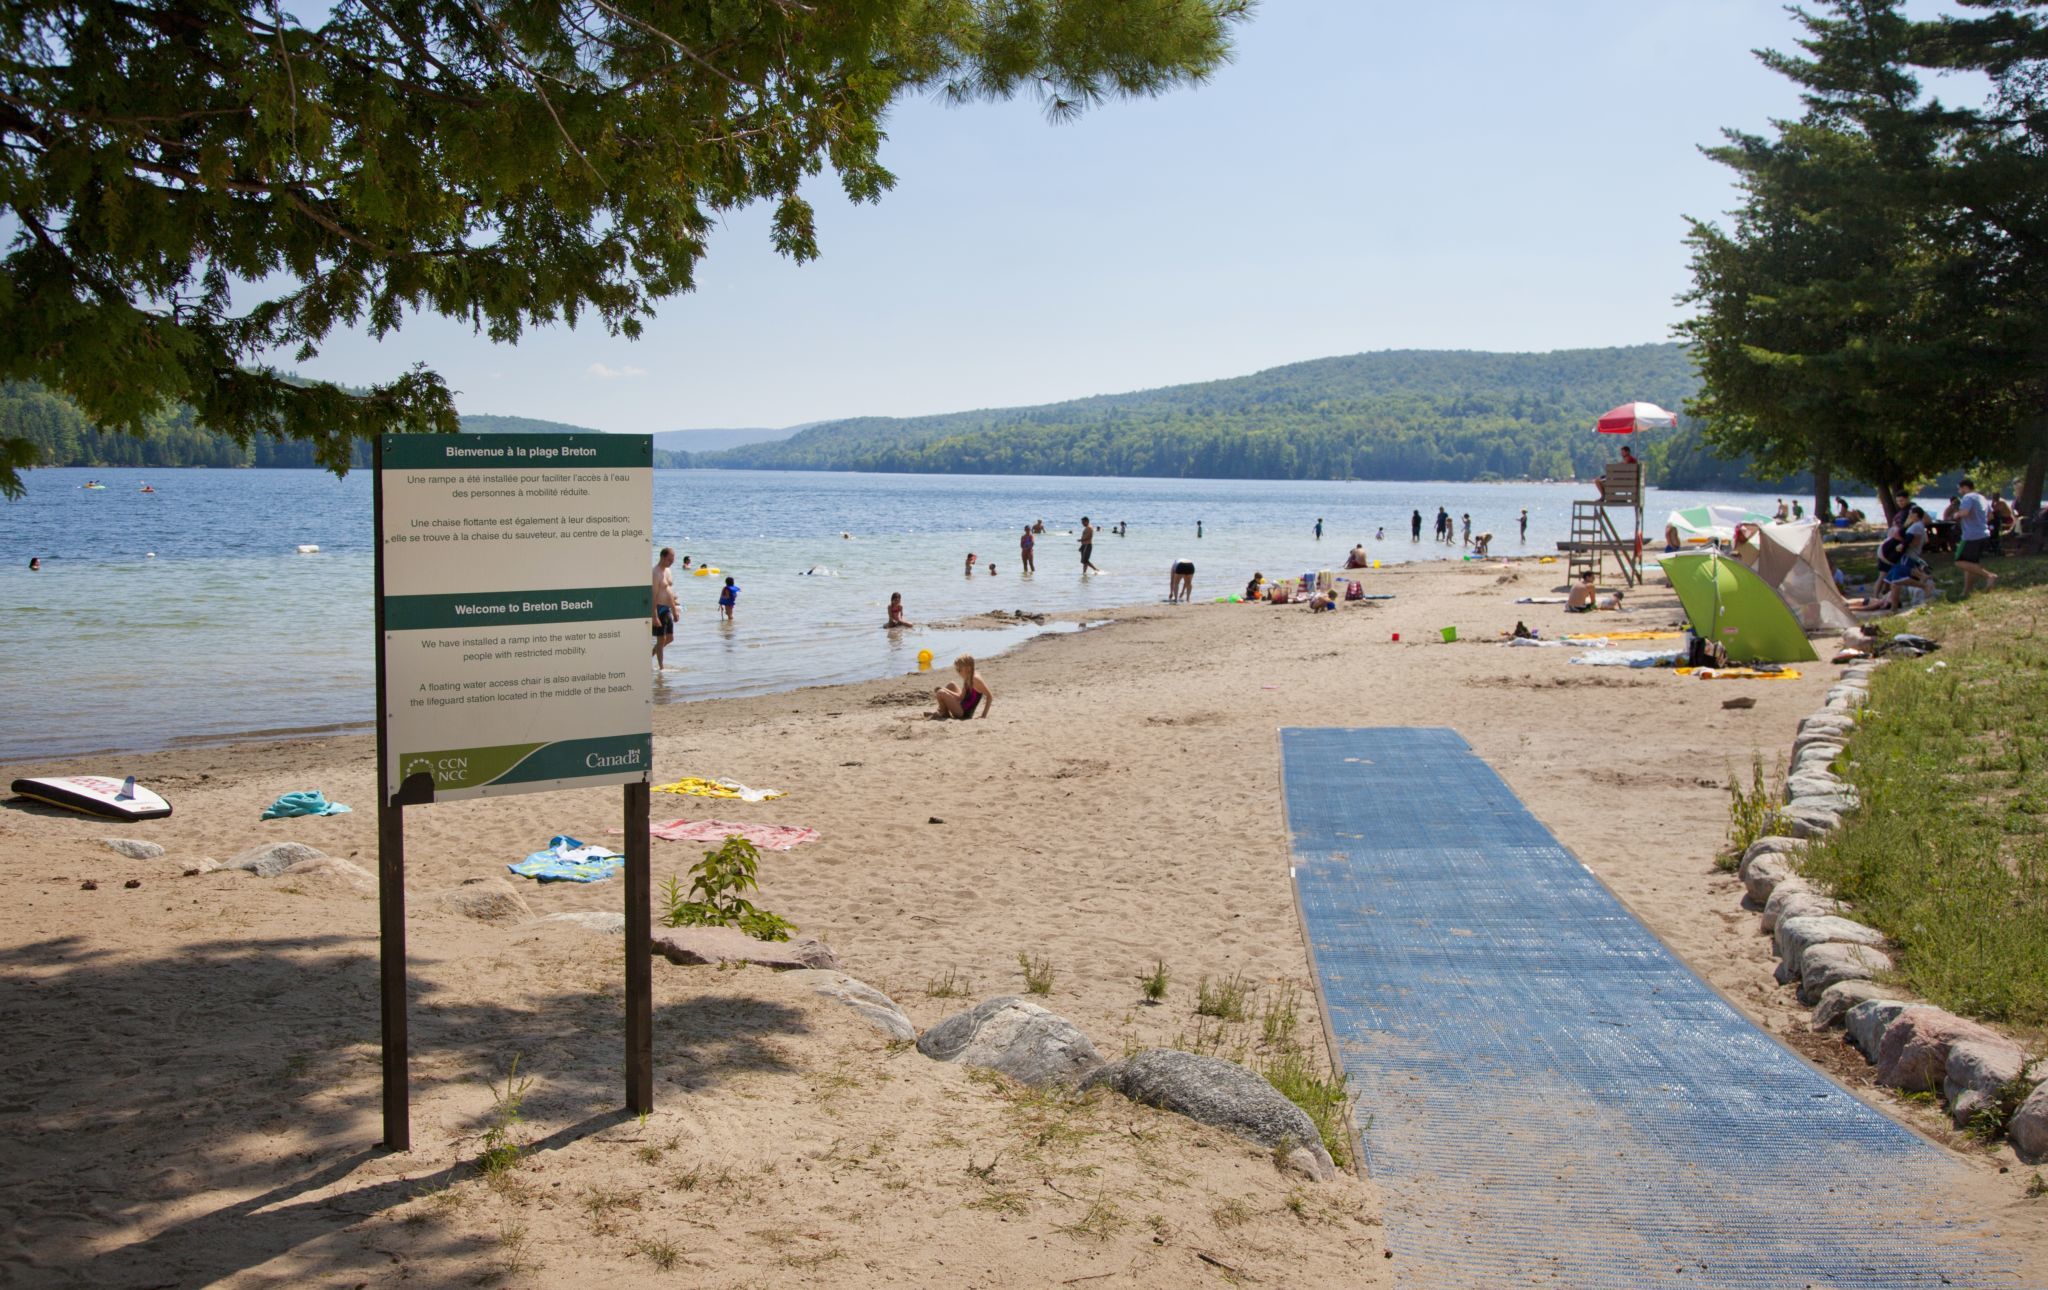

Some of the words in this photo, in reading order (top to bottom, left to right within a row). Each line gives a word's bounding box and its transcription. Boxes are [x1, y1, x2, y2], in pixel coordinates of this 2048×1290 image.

[446, 447, 504, 456] Bienvenue
[508, 447, 513, 456] à
[517, 447, 526, 456] la
[529, 447, 558, 459] plage
[562, 447, 596, 456] Breton
[407, 476, 426, 484] Une
[429, 476, 457, 485] rampe
[467, 474, 480, 483] été
[483, 474, 518, 483] installée
[521, 475, 539, 484] pour
[542, 474, 570, 482] faciliter
[573, 474, 600, 482] l'accès
[452, 489, 468, 497] des
[471, 490, 515, 499] personnes
[518, 488, 524, 497] à
[526, 488, 558, 496] mobilité
[560, 488, 590, 496] réduite.
[411, 519, 429, 527] Une
[432, 518, 461, 527] chaise
[463, 517, 497, 526] flottante
[500, 517, 512, 525] est
[515, 516, 558, 527] également
[561, 516, 566, 524] à
[569, 516, 583, 524] leur
[586, 515, 630, 525] disposition;
[391, 534, 407, 542] elle
[453, 533, 459, 541] à
[461, 533, 469, 541] la
[471, 532, 500, 540] chaise
[515, 531, 558, 540] sauveteur,
[573, 530, 597, 538] centre
[600, 529, 610, 537] de
[622, 529, 645, 538] plage.
[455, 604, 506, 615] Welcome
[509, 604, 519, 613] to
[522, 602, 558, 612] Breton
[561, 600, 593, 610] Beach
[422, 640, 436, 648] We
[439, 639, 460, 648] have
[463, 638, 498, 646] installed
[509, 637, 529, 646] ramp
[533, 635, 547, 643] into
[550, 634, 562, 642] the
[565, 633, 586, 641] water
[598, 631, 620, 639] assist
[463, 652, 492, 662] people
[495, 650, 512, 659] with
[515, 648, 553, 658] restricted
[555, 647, 587, 656] mobility.
[420, 683, 426, 691] A
[429, 682, 460, 693] floating
[489, 679, 518, 688] access
[521, 677, 541, 685] chair
[544, 676, 551, 684] is
[553, 675, 569, 683] also
[572, 672, 606, 682] available
[609, 671, 626, 679] from
[410, 698, 424, 707] the
[427, 696, 464, 707] lifeguard
[467, 694, 495, 703] station
[498, 691, 528, 701] located
[530, 691, 537, 699] in
[540, 690, 552, 698] the
[555, 687, 582, 697] middle
[584, 687, 592, 695] of
[594, 686, 606, 694] the
[608, 684, 634, 693] beach.
[439, 758, 467, 770] CCN
[586, 752, 640, 768] Canada
[439, 770, 467, 781] NCC
